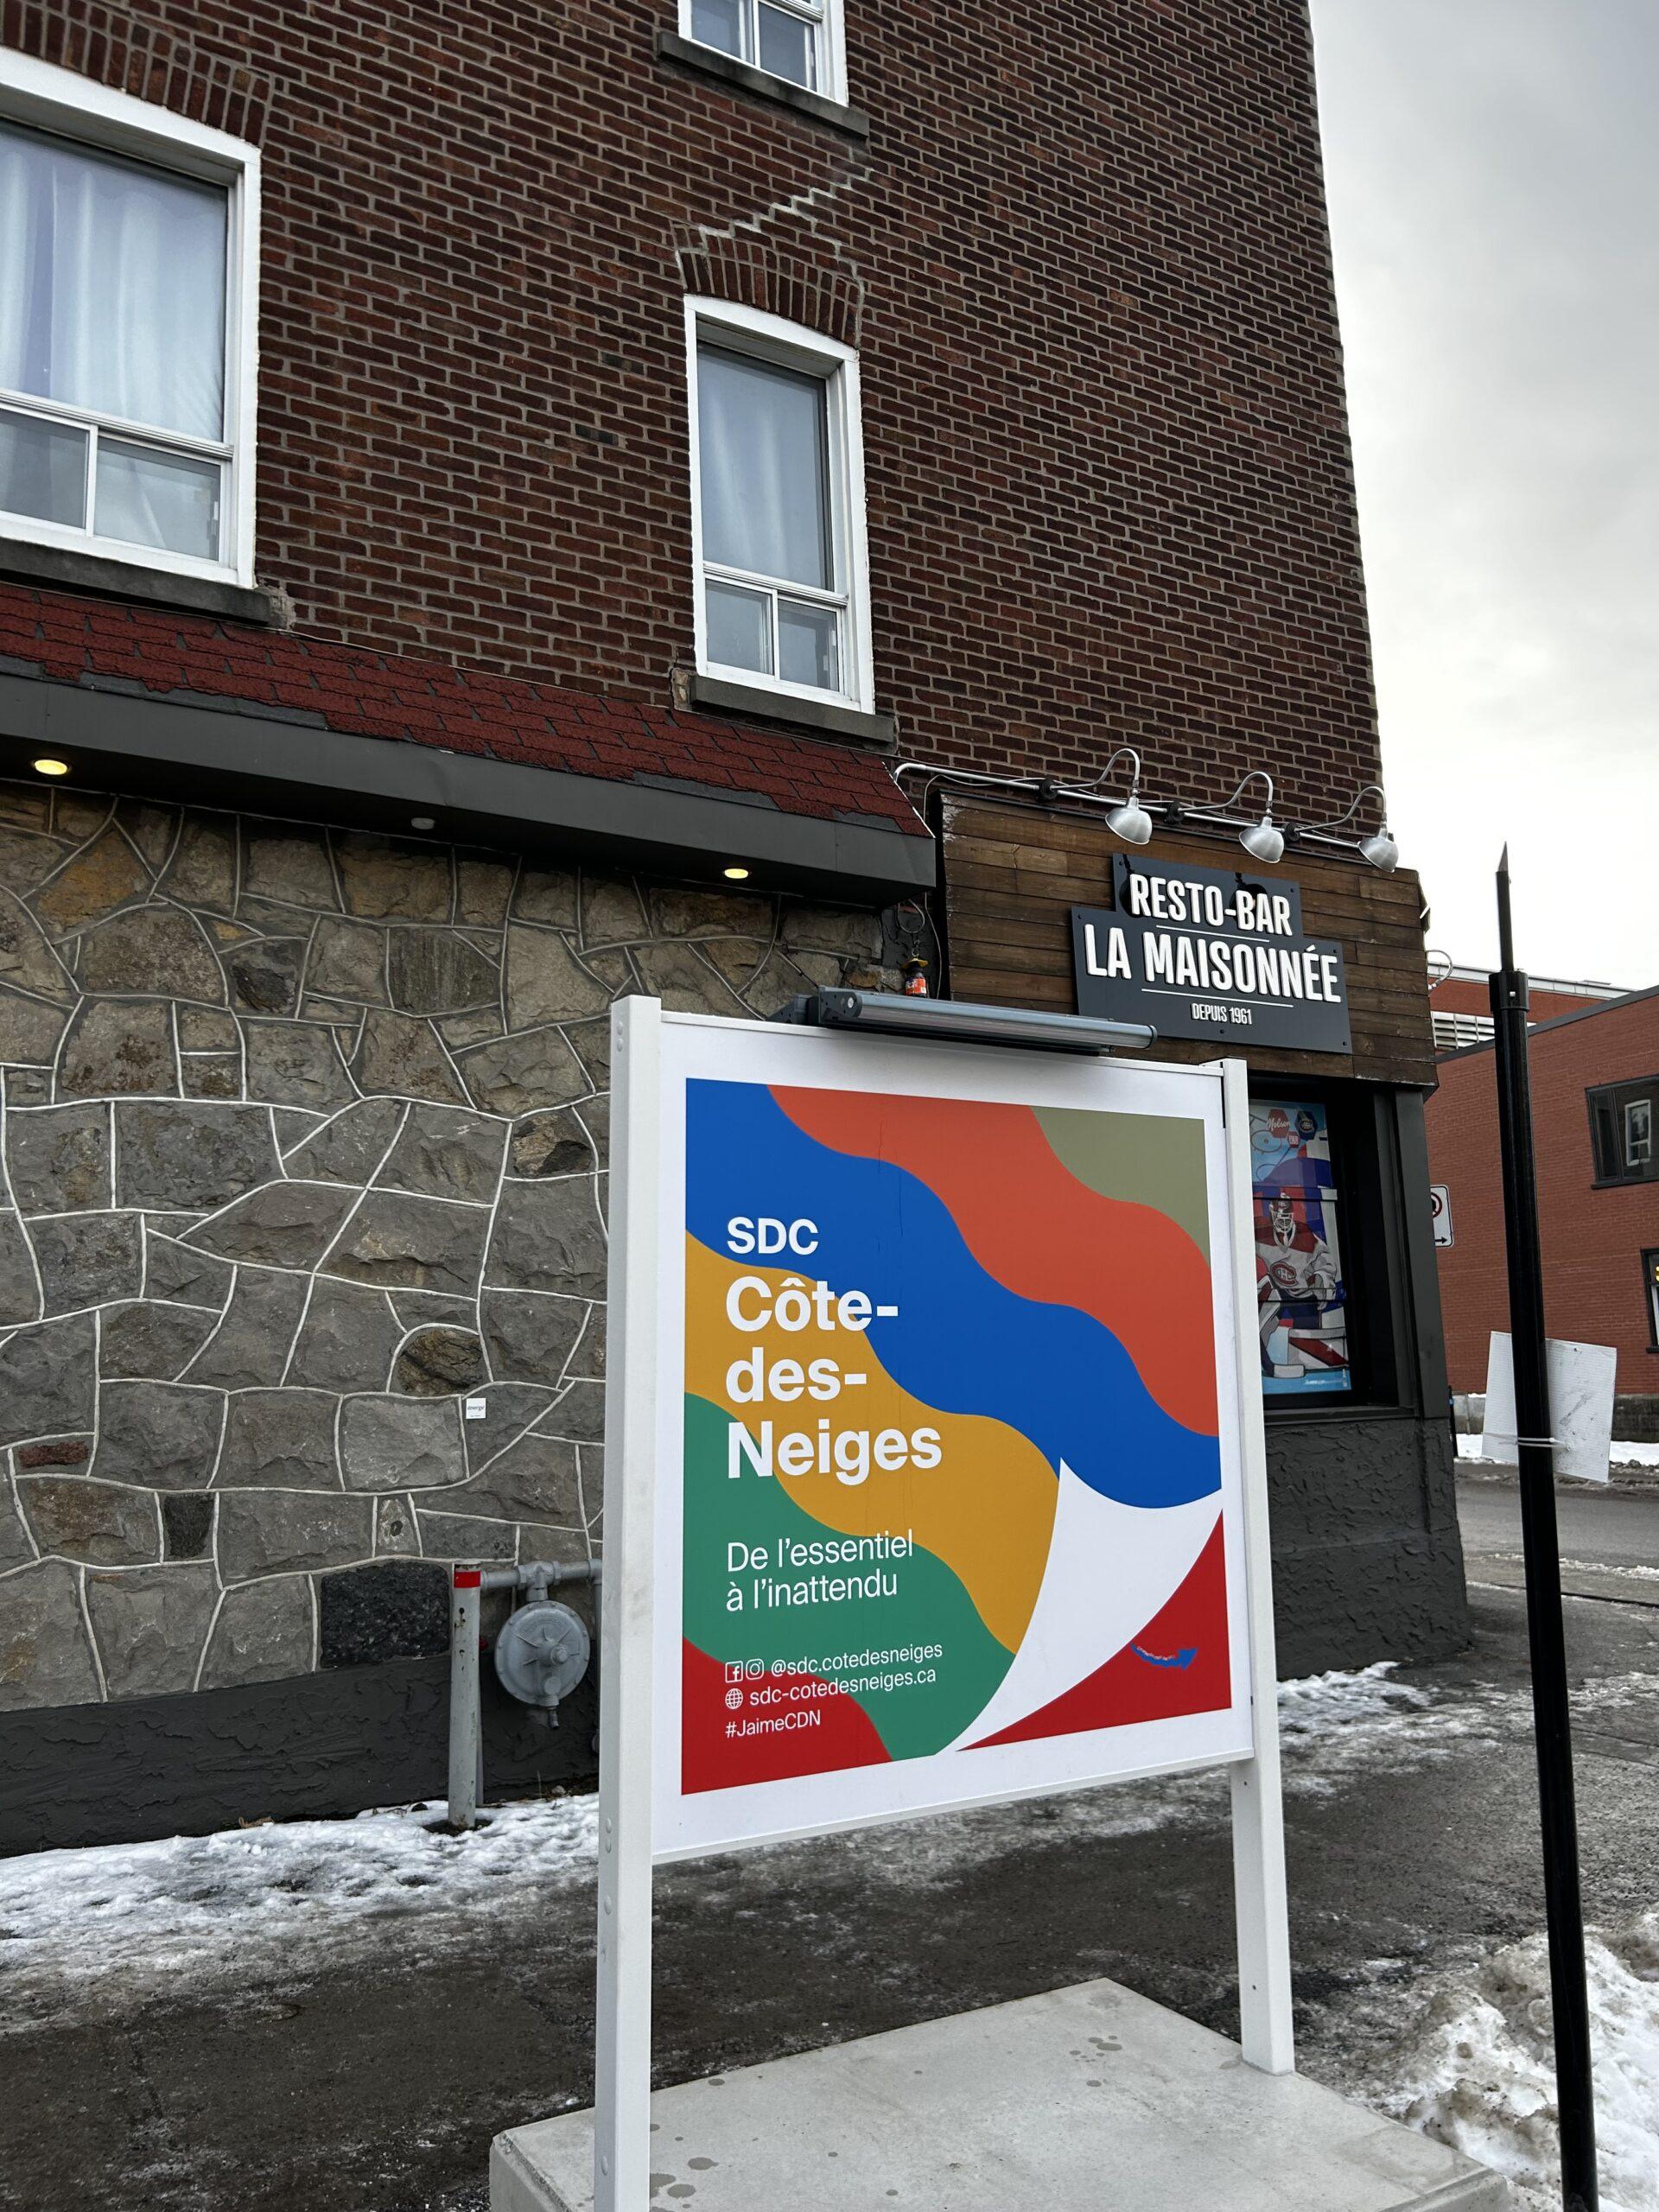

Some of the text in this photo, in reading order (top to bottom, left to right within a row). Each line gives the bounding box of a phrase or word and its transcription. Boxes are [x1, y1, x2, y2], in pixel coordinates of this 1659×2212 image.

[1129, 873, 1294, 937] RESTO-BAR
[1084, 923, 1342, 1003] LA MAISONNÉE
[1191, 1002, 1253, 1025] DEPUIS 1961
[727, 1216, 819, 1255] SDC
[725, 1275, 899, 1333] Côte-
[725, 1346, 868, 1404] des-
[728, 1418, 943, 1486] Neiges
[728, 1528, 913, 1573] De l'essentiel
[726, 1567, 897, 1612] à l'inattendu
[771, 1643, 943, 1677] @sdc.cotedesneiges
[749, 1669, 937, 1707] sdc-cotedesneiges.ca
[725, 1709, 821, 1738] #JaimeCDN
